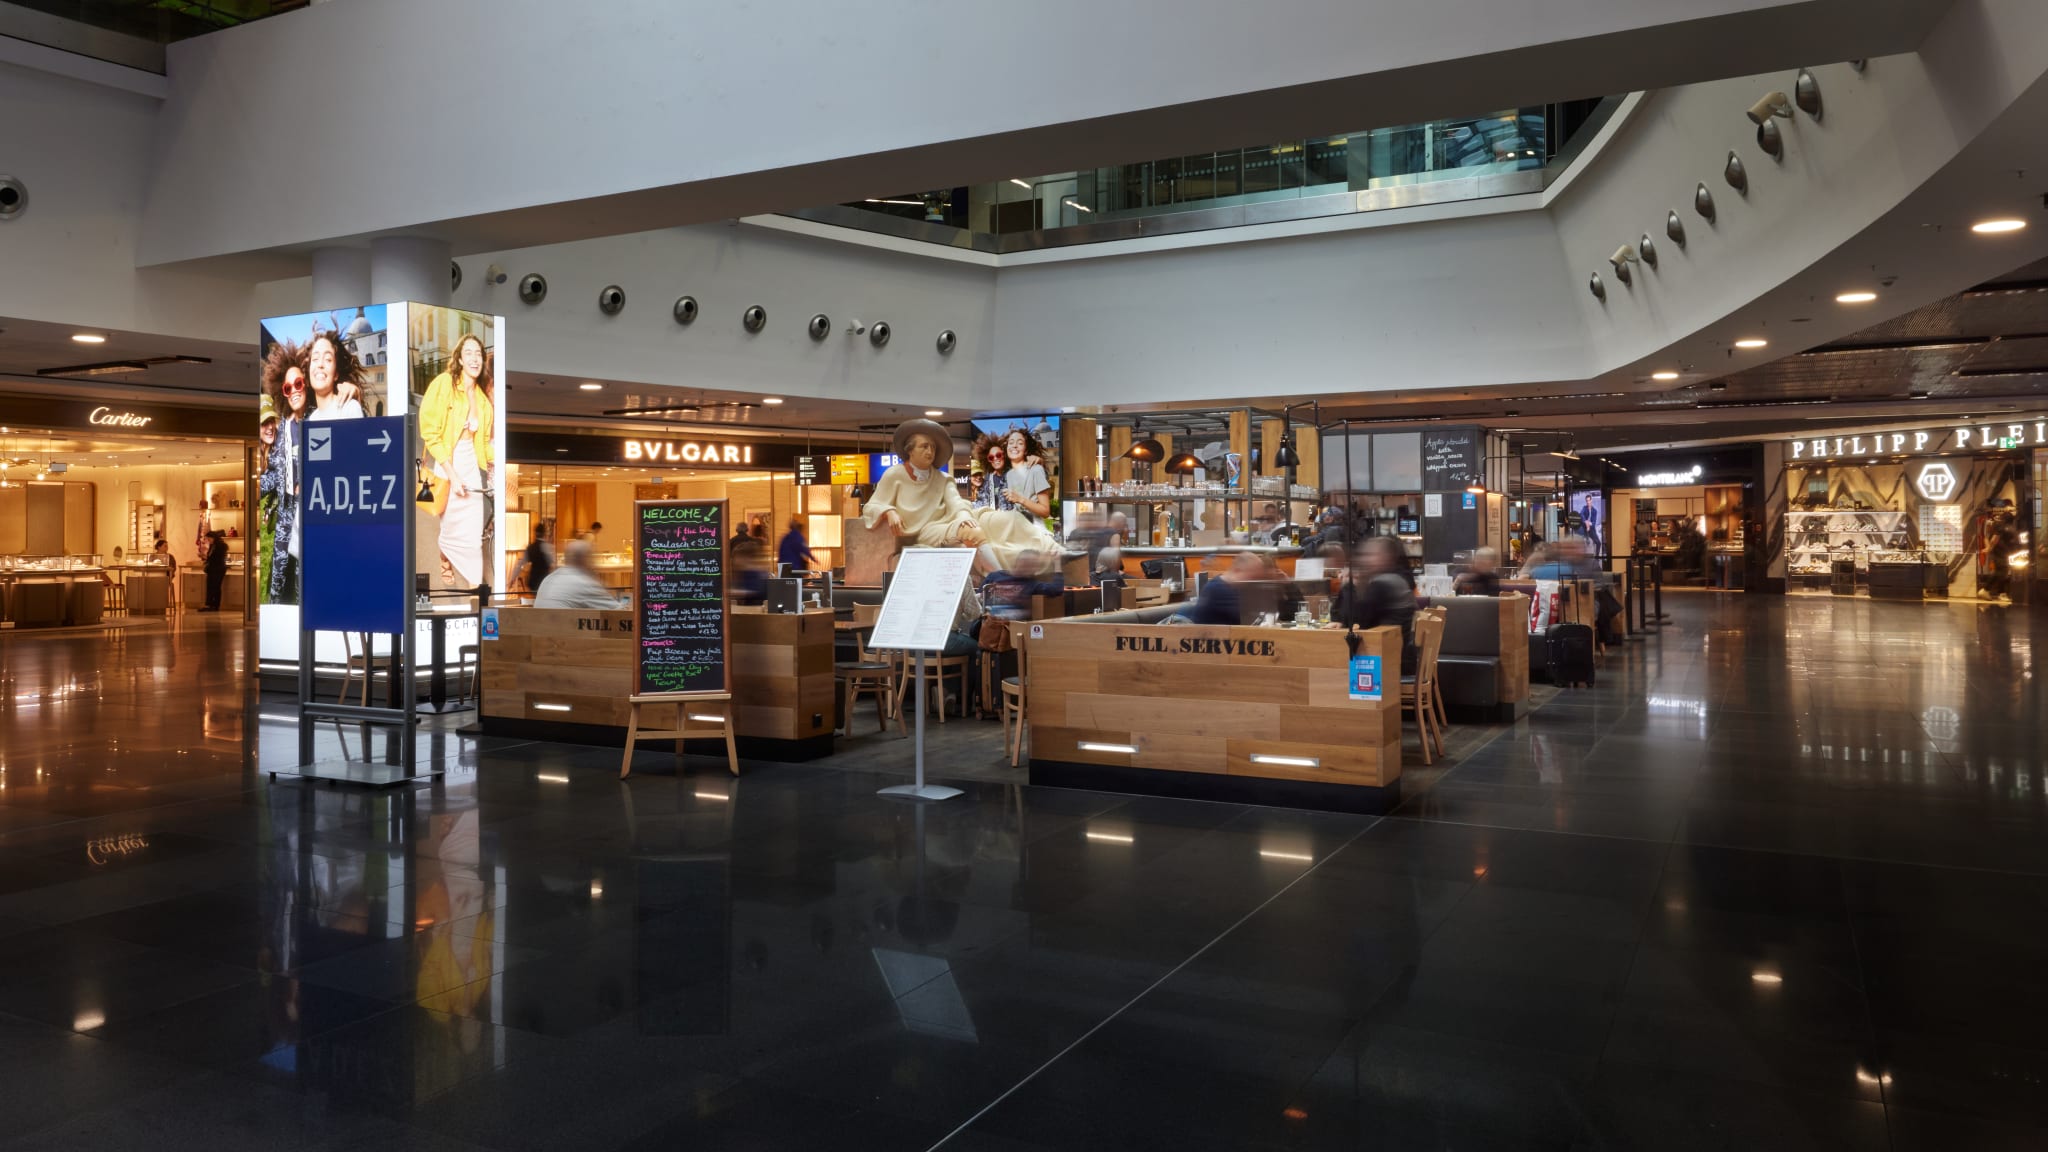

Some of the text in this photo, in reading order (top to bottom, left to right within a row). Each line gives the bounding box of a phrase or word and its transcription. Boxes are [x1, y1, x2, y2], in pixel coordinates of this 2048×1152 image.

[89, 406, 152, 428] Cartier
[625, 440, 751, 464] BVLGARI
[1792, 432, 1928, 458] PHILIPP
[643, 508, 702, 519] WELCOME
[699, 525, 716, 537] Day
[577, 617, 612, 631] FULL
[1115, 636, 1275, 656] FULL SERVICE
